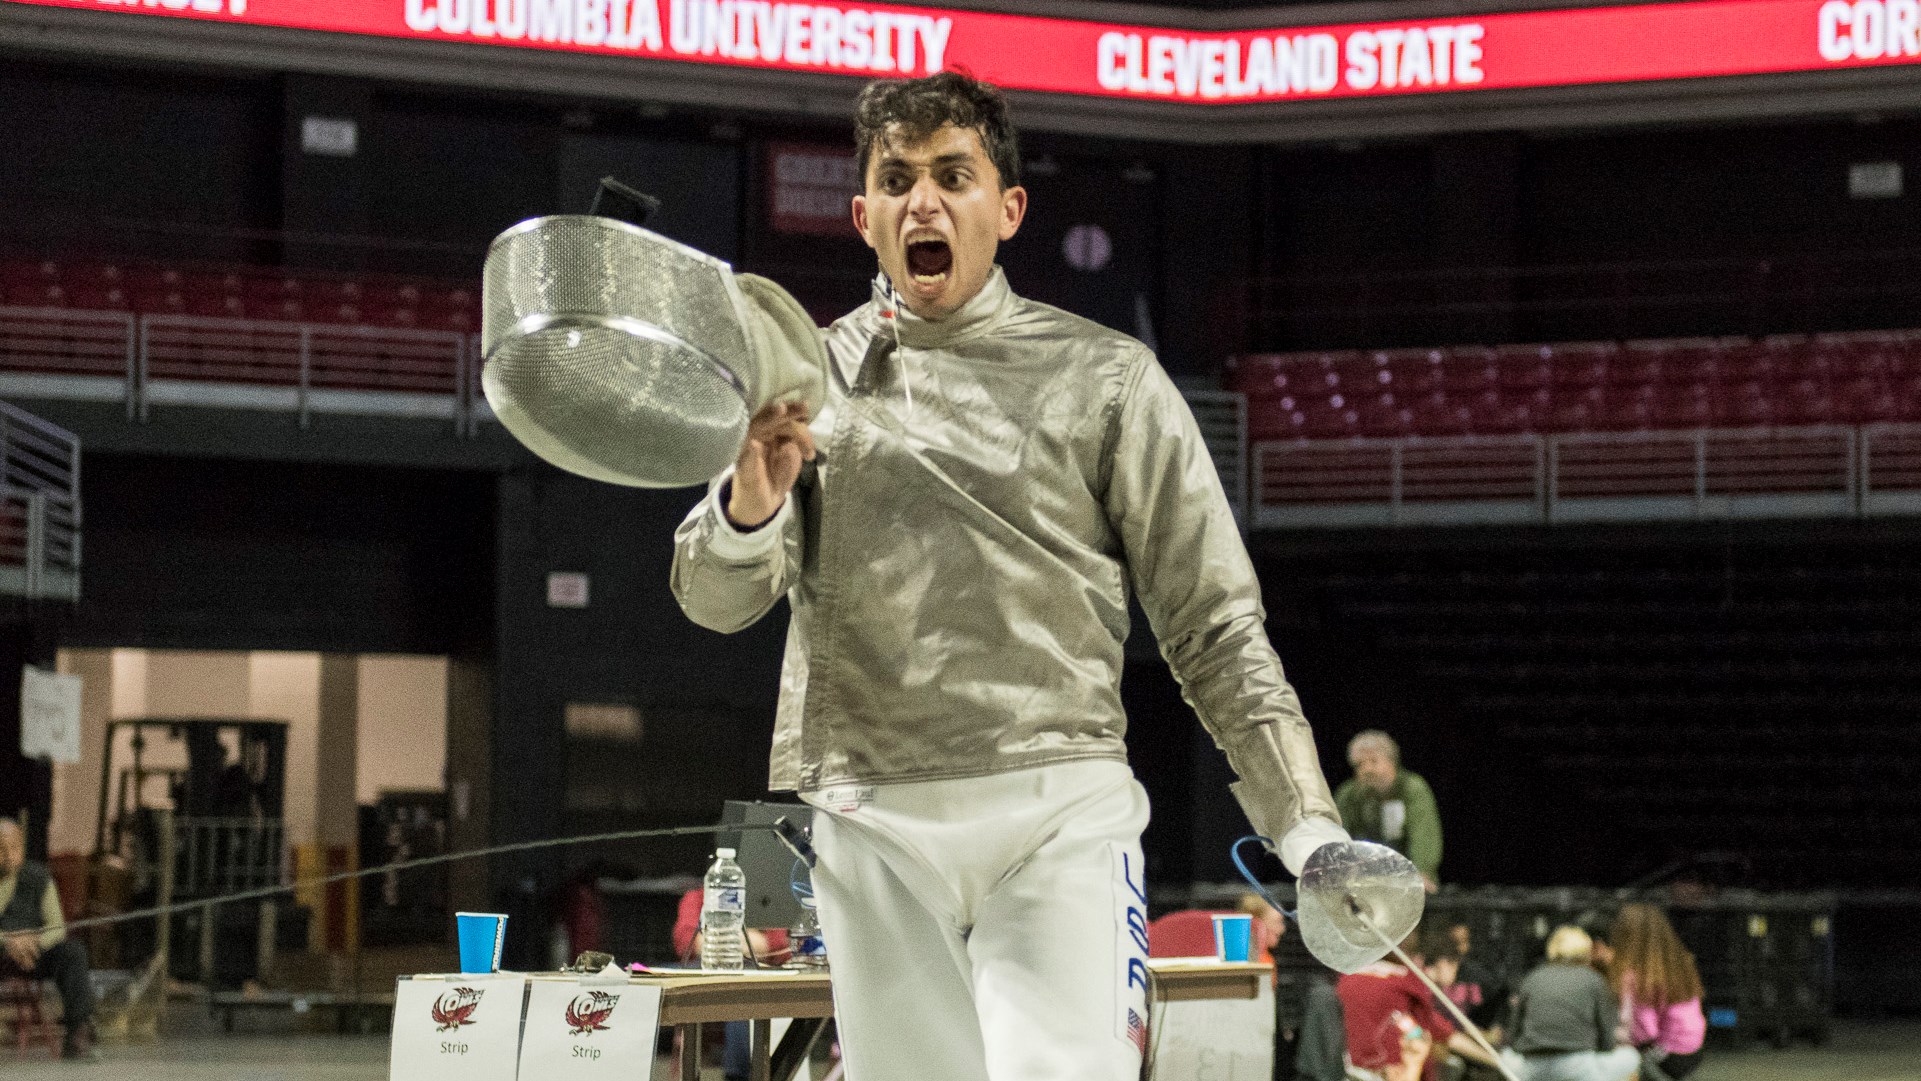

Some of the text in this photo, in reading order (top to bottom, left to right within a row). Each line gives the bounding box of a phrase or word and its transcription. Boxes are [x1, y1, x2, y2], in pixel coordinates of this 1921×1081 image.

[405, 0, 953, 74] COLUMBIA UNIVERSITY
[1097, 23, 1484, 98] CLEVELAND STATE
[440, 1041, 469, 1055] Strip
[571, 1044, 601, 1060] Strip
